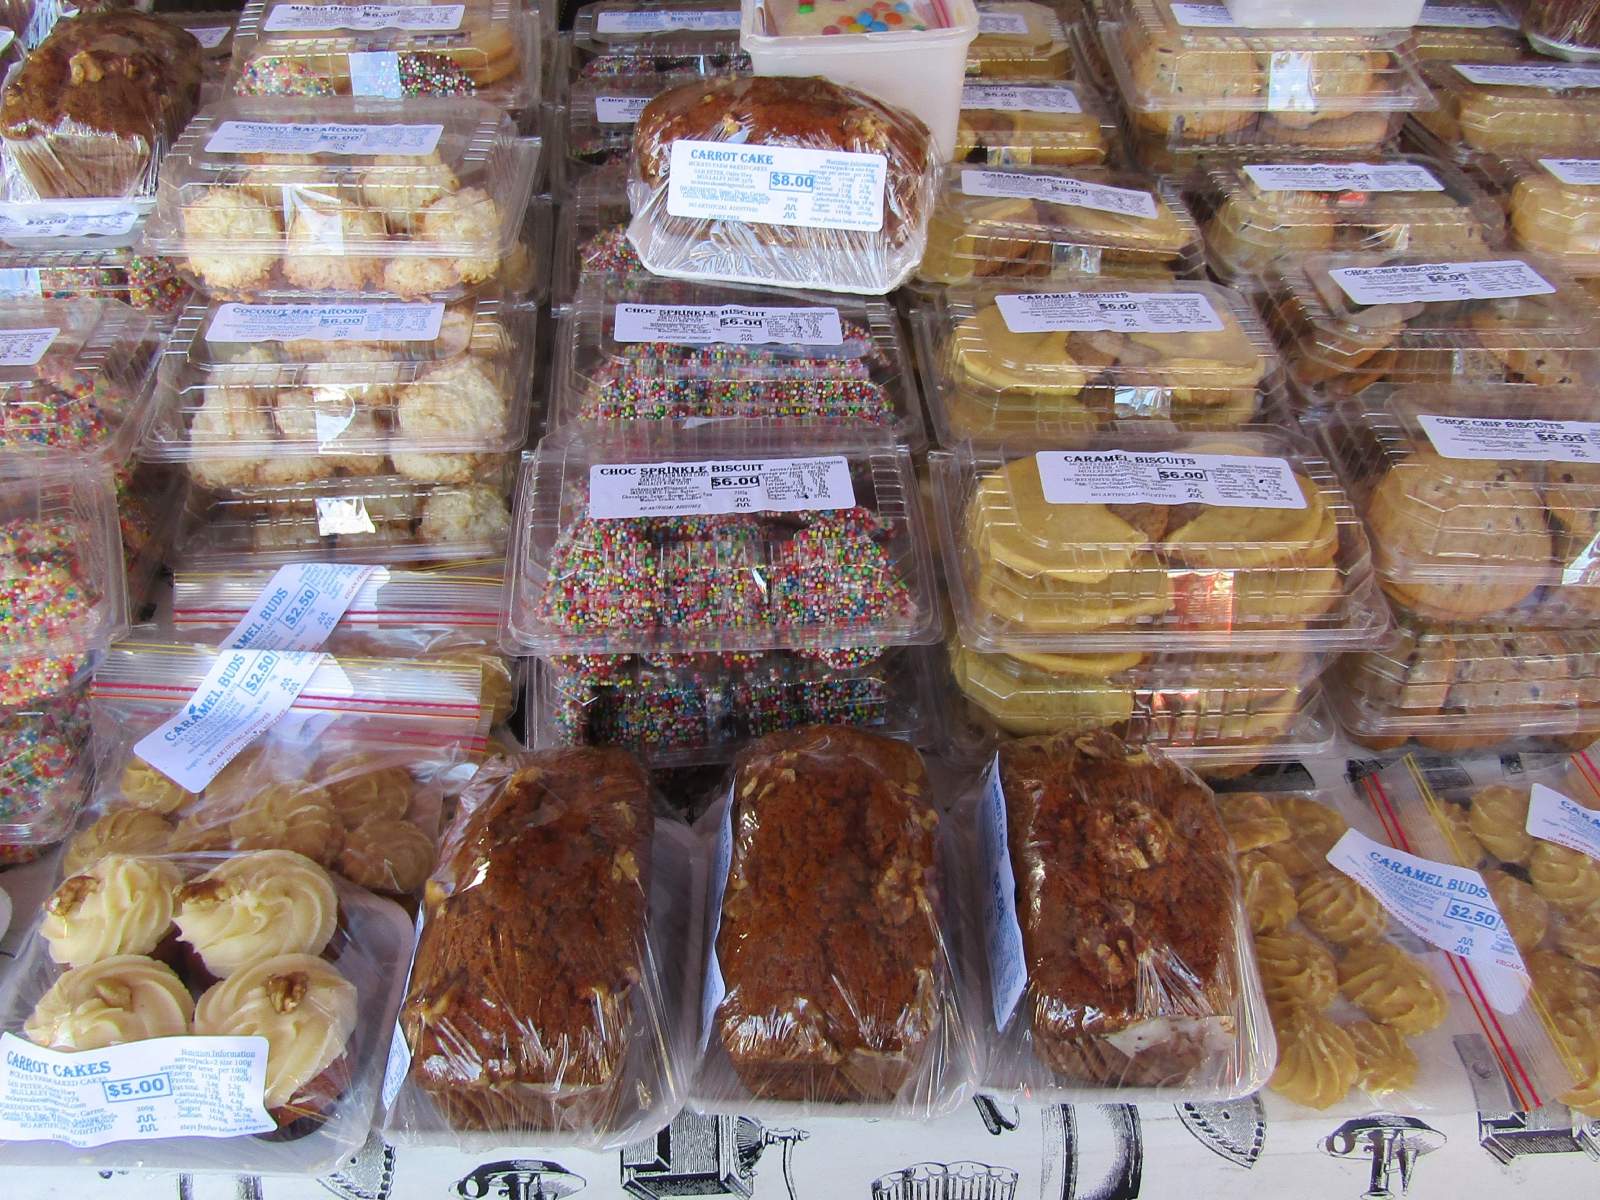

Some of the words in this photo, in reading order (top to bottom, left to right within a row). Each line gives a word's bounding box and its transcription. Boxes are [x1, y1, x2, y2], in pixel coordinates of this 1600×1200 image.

[690, 149, 738, 162] CARROT
[740, 153, 774, 165] CAKE
[771, 173, 814, 188] $8.00
[1343, 267, 1373, 276] CHOC
[1374, 266, 1397, 275] CHIP
[1400, 265, 1449, 273] BISCUITS
[1017, 293, 1076, 302] CARAMEL
[1078, 292, 1129, 300] BISCUITS
[232, 307, 288, 317] COCONUT
[291, 307, 368, 316] MACAROONS
[658, 308, 718, 317] SPRINKLE
[720, 308, 767, 317] BISCUIT
[1435, 417, 1469, 427] CHOC
[1472, 420, 1503, 428] CHIP
[1506, 421, 1565, 431] BISCUITS
[1537, 433, 1585, 443] $6.00
[1063, 454, 1132, 465] CARAMEL
[1135, 456, 1196, 467] BISCUITS
[600, 467, 637, 476] CHOC
[639, 466, 707, 475] SPRINKLE
[711, 464, 764, 473] BISCUIT
[1159, 470, 1204, 481] $6.00
[712, 475, 760, 488] $6.00
[259, 587, 289, 622] BUDS
[285, 588, 315, 626] $2.50
[245, 653, 276, 692] $2.50
[163, 689, 225, 742] CARAMEL
[217, 653, 246, 689] BUDS
[1369, 851, 1444, 888] CARAMEL
[1447, 878, 1489, 899] BUDS
[1449, 904, 1497, 926] $2.50
[212, 1049, 256, 1058] Information
[7, 1050, 50, 1075] CARROT
[52, 1060, 112, 1078] CAKES
[107, 1077, 165, 1098] $5.00
